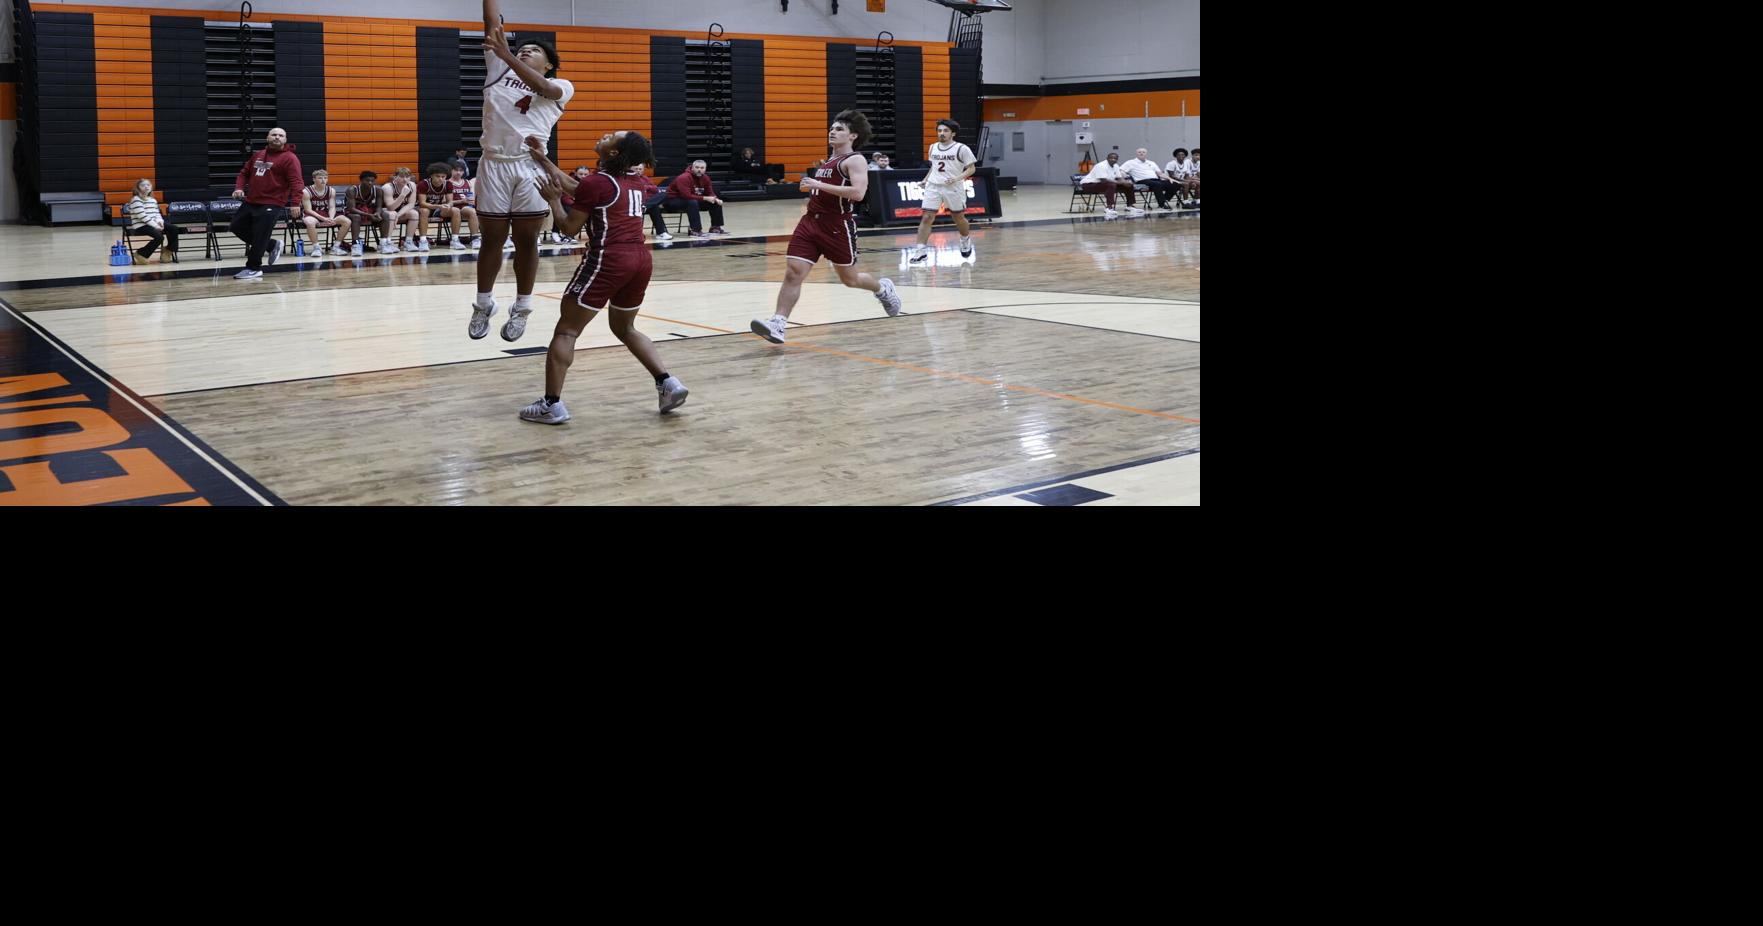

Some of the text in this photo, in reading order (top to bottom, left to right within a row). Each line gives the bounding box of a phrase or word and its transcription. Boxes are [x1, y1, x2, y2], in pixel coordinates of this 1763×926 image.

[514, 95, 532, 114] 4
[938, 161, 946, 172] 2
[628, 189, 643, 217] 10
